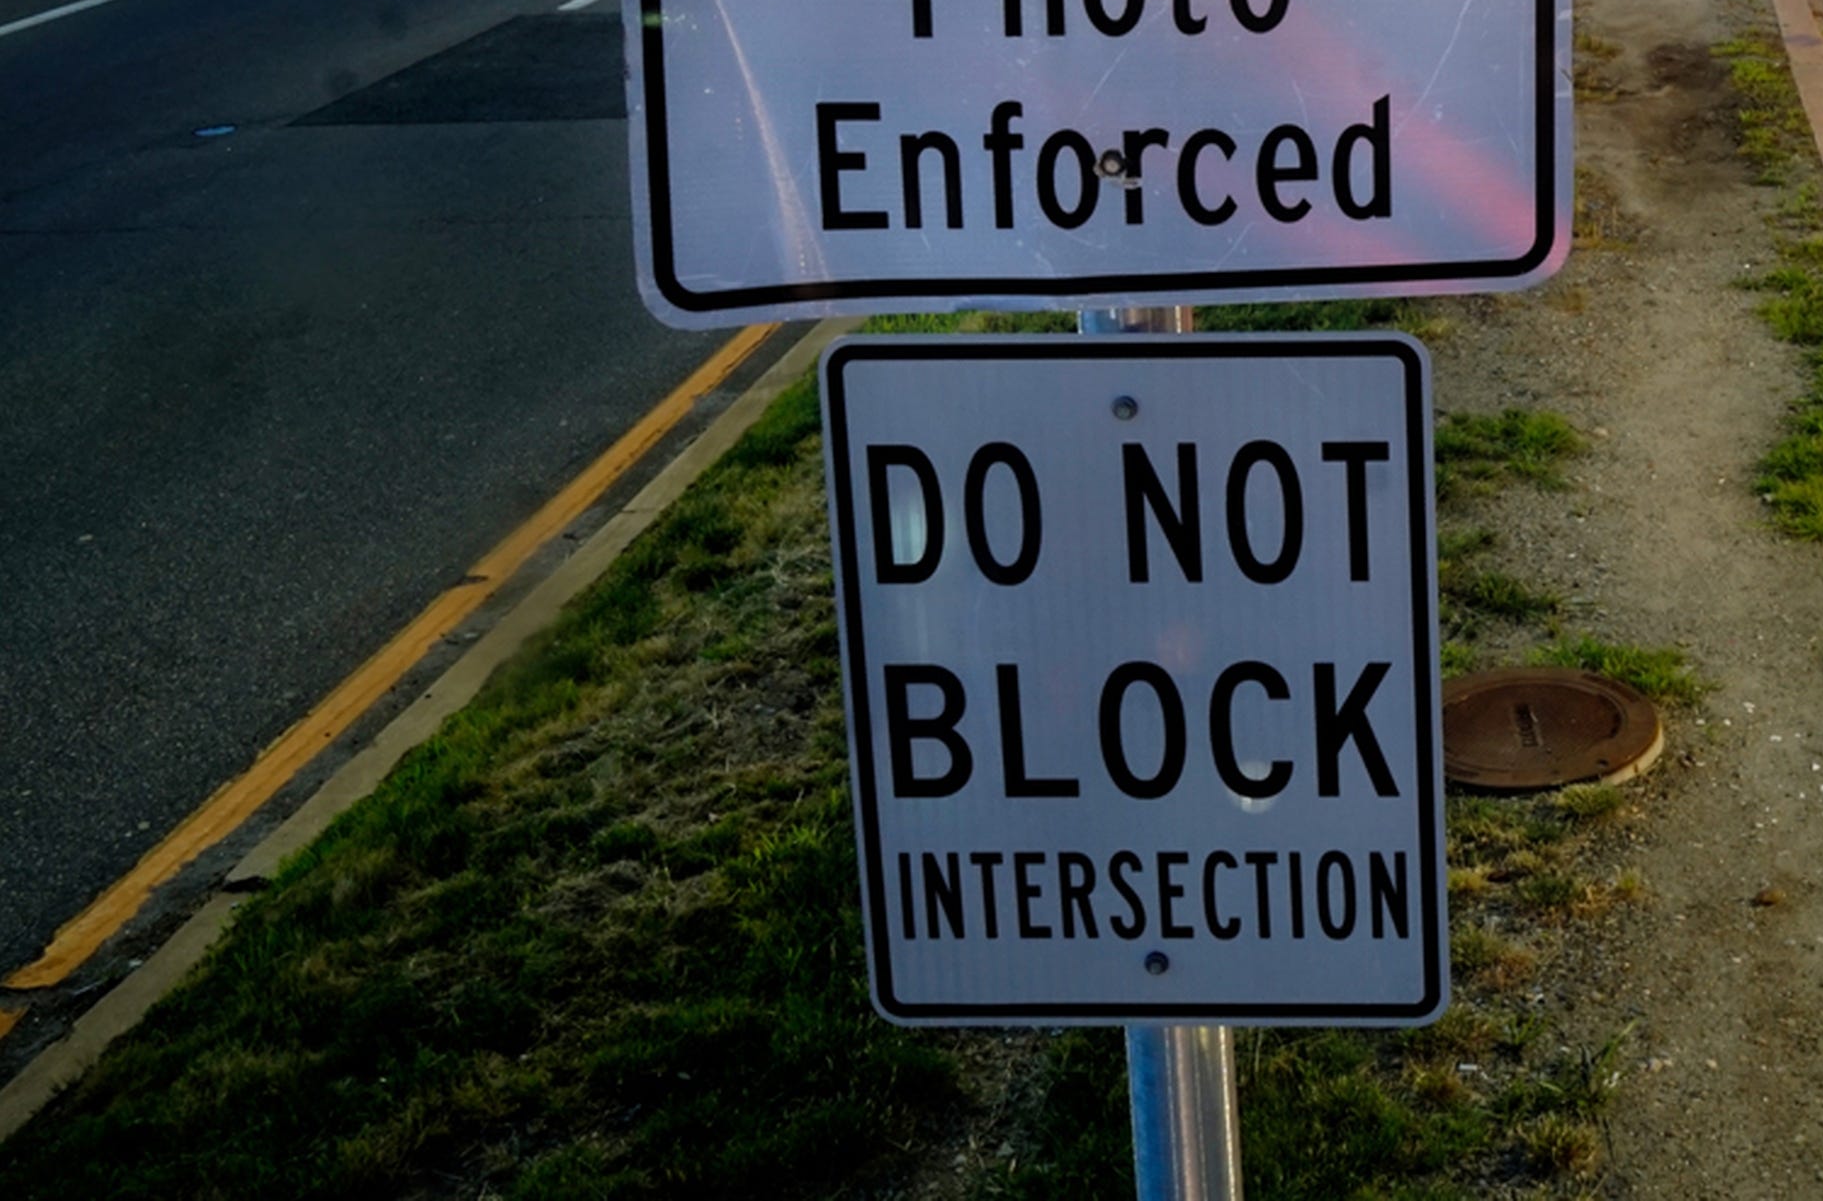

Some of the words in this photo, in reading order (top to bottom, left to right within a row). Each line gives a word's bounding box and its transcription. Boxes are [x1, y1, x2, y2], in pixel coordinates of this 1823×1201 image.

[815, 93, 1393, 231] Enforced
[866, 441, 1043, 586] DO
[1121, 439, 1390, 584] NOT
[883, 660, 1400, 799] BLOCK
[898, 849, 1410, 942] INTERSECTION
